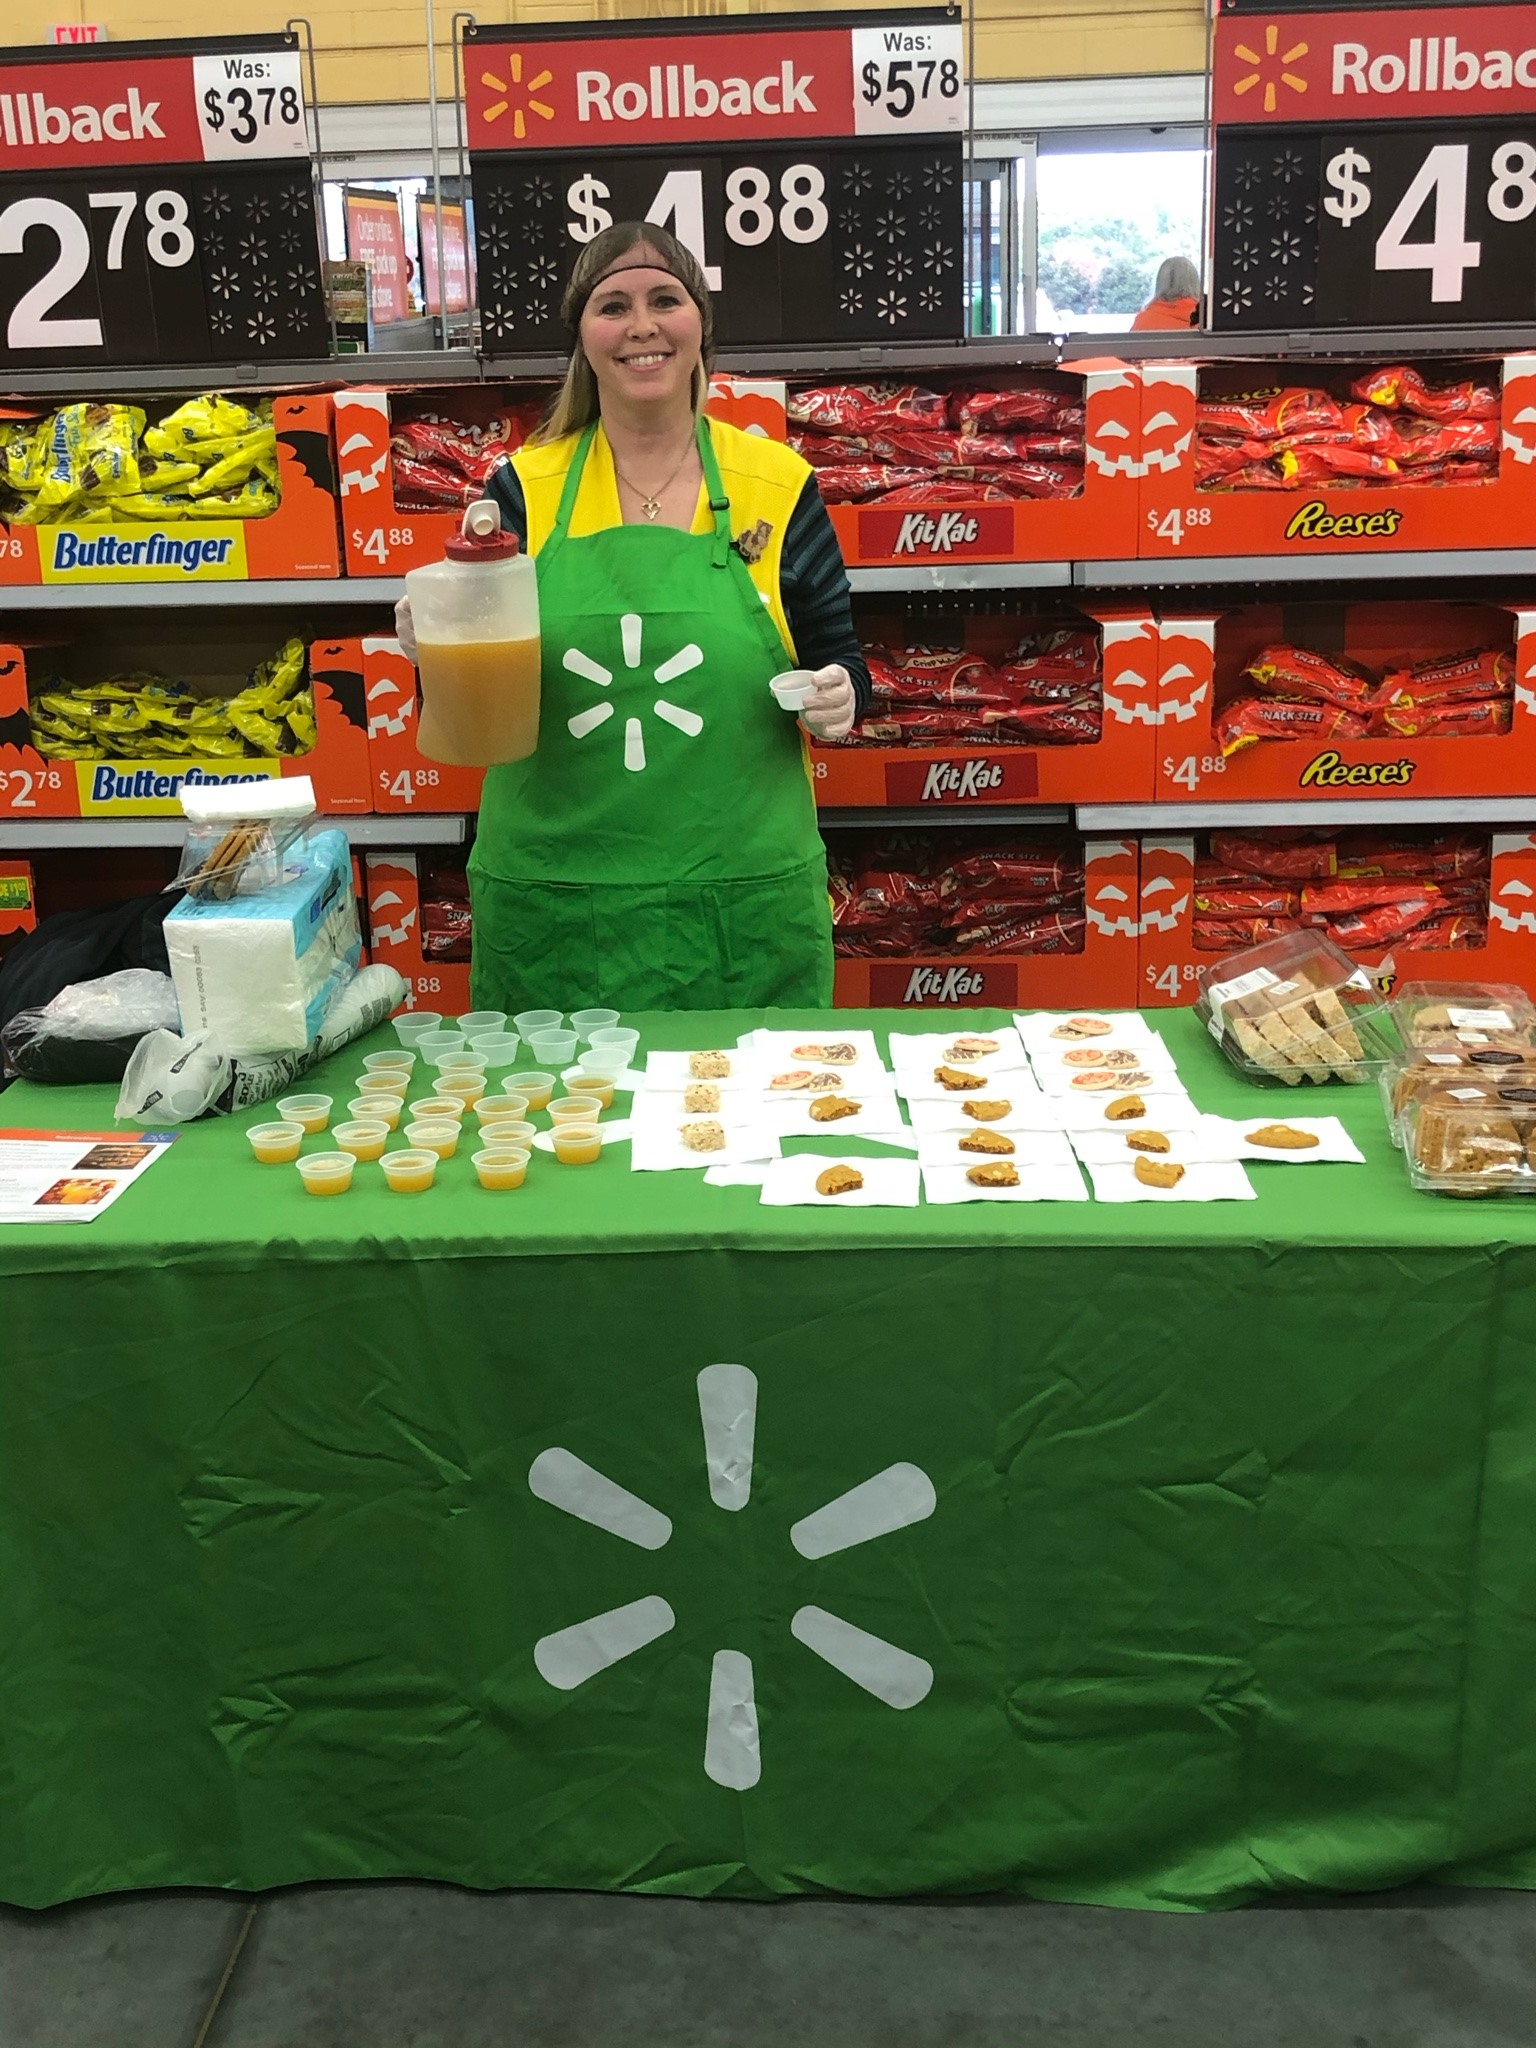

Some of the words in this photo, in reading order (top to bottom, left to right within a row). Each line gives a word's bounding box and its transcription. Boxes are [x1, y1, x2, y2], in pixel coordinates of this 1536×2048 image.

[883, 32, 932, 51] Was:
[223, 59, 271, 79] Was:
[1332, 37, 1536, 94] Rollbac
[576, 60, 818, 122] Rollback
[0, 87, 166, 146] llback
[895, 512, 979, 553] KitKat
[1286, 500, 1402, 540] Reese's
[54, 532, 233, 571] Butterfinger
[1297, 711, 1323, 723] SIZE
[921, 760, 1003, 801] KitKat
[1300, 750, 1417, 788] Reese's
[984, 928, 1019, 950] SNACK
[904, 967, 984, 1003] KitKat
